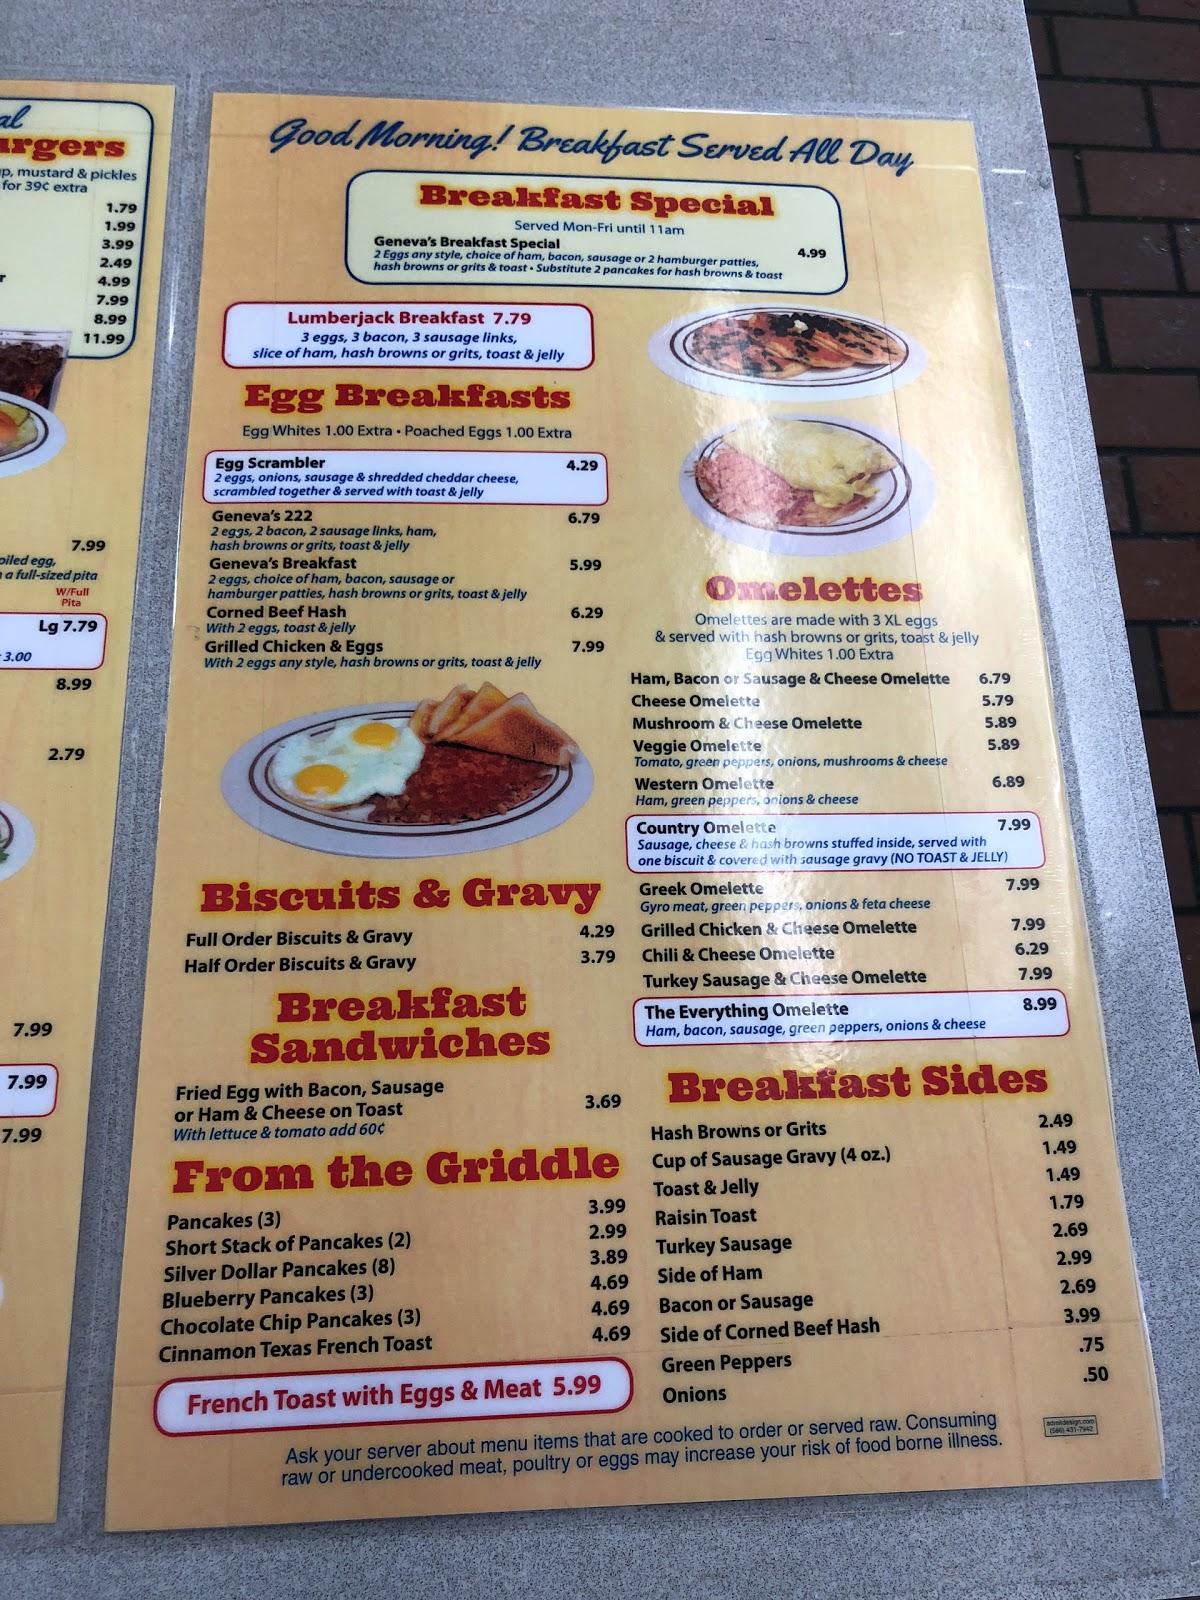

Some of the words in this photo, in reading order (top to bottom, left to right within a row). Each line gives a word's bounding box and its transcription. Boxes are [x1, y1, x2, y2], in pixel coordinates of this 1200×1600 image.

[269, 118, 361, 154] Good
[354, 120, 516, 160] Morning!
[517, 125, 677, 164] Breakfast
[677, 132, 790, 163] Served
[789, 137, 843, 164] All
[847, 138, 915, 177] Day
[17, 167, 74, 178] mustard
[77, 168, 87, 179] &
[90, 169, 137, 181] pickles
[2, 179, 21, 190] for
[53, 183, 87, 193] extra
[106, 202, 137, 213] 1.79
[419, 184, 621, 210] Breakfast
[630, 190, 774, 218] Special
[104, 220, 135, 231] 1.99
[514, 220, 559, 231] Served
[563, 221, 612, 232] Mon-Fri
[616, 223, 645, 233] until
[650, 224, 684, 234] 11am
[101, 239, 134, 250] 3.99
[440, 236, 507, 248] Breakfast
[510, 237, 560, 250] Special
[797, 248, 826, 258] 4.99
[99, 257, 132, 268] 2.49
[97, 276, 130, 287] 4.99
[96, 294, 128, 306] 7.99
[93, 313, 127, 325] 8.99
[287, 310, 394, 327] Lumberjack
[399, 310, 484, 324] Breakfast
[493, 312, 531, 325] 7.79
[83, 332, 124, 344] 11.99
[300, 332, 309, 342] 3
[312, 334, 347, 345] eggs,
[351, 331, 359, 342] 3
[362, 331, 408, 343] bacon,
[412, 331, 420, 342] 3
[423, 334, 479, 345] sausage
[482, 331, 517, 344] links,
[244, 384, 324, 414] Egg
[334, 383, 570, 409] Breakfasts
[215, 457, 244, 471] Egg
[247, 456, 325, 468] Scrambler
[566, 460, 598, 471] 4.29
[214, 473, 222, 482] 2
[224, 474, 254, 484] eggs,
[258, 472, 301, 483] onions,
[304, 474, 353, 484] sausage
[355, 472, 365, 481] &
[367, 472, 423, 482] shredded
[425, 472, 474, 482] cheddar
[476, 473, 518, 484] cheese,
[284, 509, 312, 521] 222
[568, 512, 600, 524] 6.79
[71, 539, 105, 551] 7.99
[282, 556, 356, 569] Breakfast
[569, 559, 601, 570] 5.99
[55, 587, 89, 596] W/Full
[705, 575, 923, 602] Omelettes
[61, 598, 81, 607] Pita
[206, 605, 264, 618] Corned
[268, 604, 304, 618] Beef
[307, 604, 346, 617] Hash
[570, 606, 603, 618] 6.29
[38, 619, 58, 635] Lg
[63, 620, 97, 632] 7.79
[695, 612, 767, 625] Omelettes
[771, 616, 791, 625] are
[796, 613, 835, 625] made
[838, 613, 868, 625] with
[873, 614, 880, 626] 3
[884, 614, 901, 626] XL
[905, 617, 937, 629] eggs
[204, 639, 258, 653] Grilled
[262, 639, 325, 652] Chicken
[329, 639, 342, 652] &
[346, 639, 383, 655] Eggs
[572, 640, 604, 652] 7.99
[3, 651, 32, 661] 3.00
[56, 678, 92, 690] 8.99
[631, 694, 685, 707] Cheese
[689, 694, 760, 707] Omelette
[982, 694, 1013, 706] 5.79
[632, 739, 686, 755] Veggie
[690, 739, 761, 752] Omelette
[987, 738, 1020, 750] 5.89
[48, 747, 85, 760] 2.79
[634, 777, 698, 790] Western
[702, 776, 774, 789] Omelette
[992, 775, 1025, 787] 6.89
[639, 881, 687, 896] Greek
[690, 881, 763, 895] Omelette
[1005, 877, 1039, 890] 7.99
[200, 879, 400, 912] Biscuits
[412, 878, 450, 908] &
[462, 877, 601, 914] Gravy
[186, 932, 217, 946] Full
[221, 931, 272, 946] Order
[276, 930, 342, 945] Biscuits
[346, 929, 359, 943] &
[362, 929, 413, 946] Gravy
[579, 924, 614, 938] 4.29
[276, 986, 526, 1022] Breakfast
[1022, 996, 1057, 1010] 8.99
[644, 1004, 675, 1019] The
[679, 1003, 768, 1021] Everything
[772, 1001, 848, 1016] Omelette
[13, 1022, 52, 1037] 7.99
[250, 1026, 550, 1064] Sandwiches
[7, 1074, 47, 1089] 7.99
[667, 1066, 911, 1103] Breakfast
[921, 1063, 1048, 1095] Sides
[585, 1094, 621, 1109] 3.69
[2, 1127, 42, 1143] 7.99
[172, 1160, 314, 1193] From
[327, 1154, 413, 1189] the
[426, 1146, 619, 1185] Griddle
[1046, 1166, 1080, 1181] 1.49
[652, 1181, 700, 1196] Toast
[703, 1179, 717, 1195] &
[720, 1177, 759, 1197] Jelly
[588, 1198, 625, 1214] 3.99
[1049, 1194, 1084, 1209] 1.79
[167, 1212, 252, 1230] Pancakes
[257, 1210, 280, 1230] (3)
[655, 1208, 707, 1225] Raisin
[709, 1208, 757, 1223] Toast
[590, 1274, 628, 1290] 4.69
[162, 1290, 255, 1309] Blueberry
[260, 1285, 345, 1304] Pancakes
[350, 1284, 373, 1303] (3)
[592, 1325, 630, 1342] 4.69
[158, 1345, 255, 1362] Cinnamon
[259, 1341, 311, 1357] Texas
[317, 1335, 378, 1355] French
[382, 1335, 432, 1352] Toast
[1079, 1336, 1104, 1352] .75
[661, 1356, 715, 1373] Green
[720, 1354, 792, 1373] Peppers
[1083, 1365, 1108, 1382] .50
[187, 1389, 268, 1415] French
[273, 1388, 336, 1410] Toast
[341, 1383, 393, 1406] with
[400, 1383, 455, 1408] Eggs
[460, 1379, 478, 1400] &
[484, 1378, 541, 1399] Meat
[553, 1374, 601, 1396] 5.99
[662, 1385, 726, 1403] Onions
